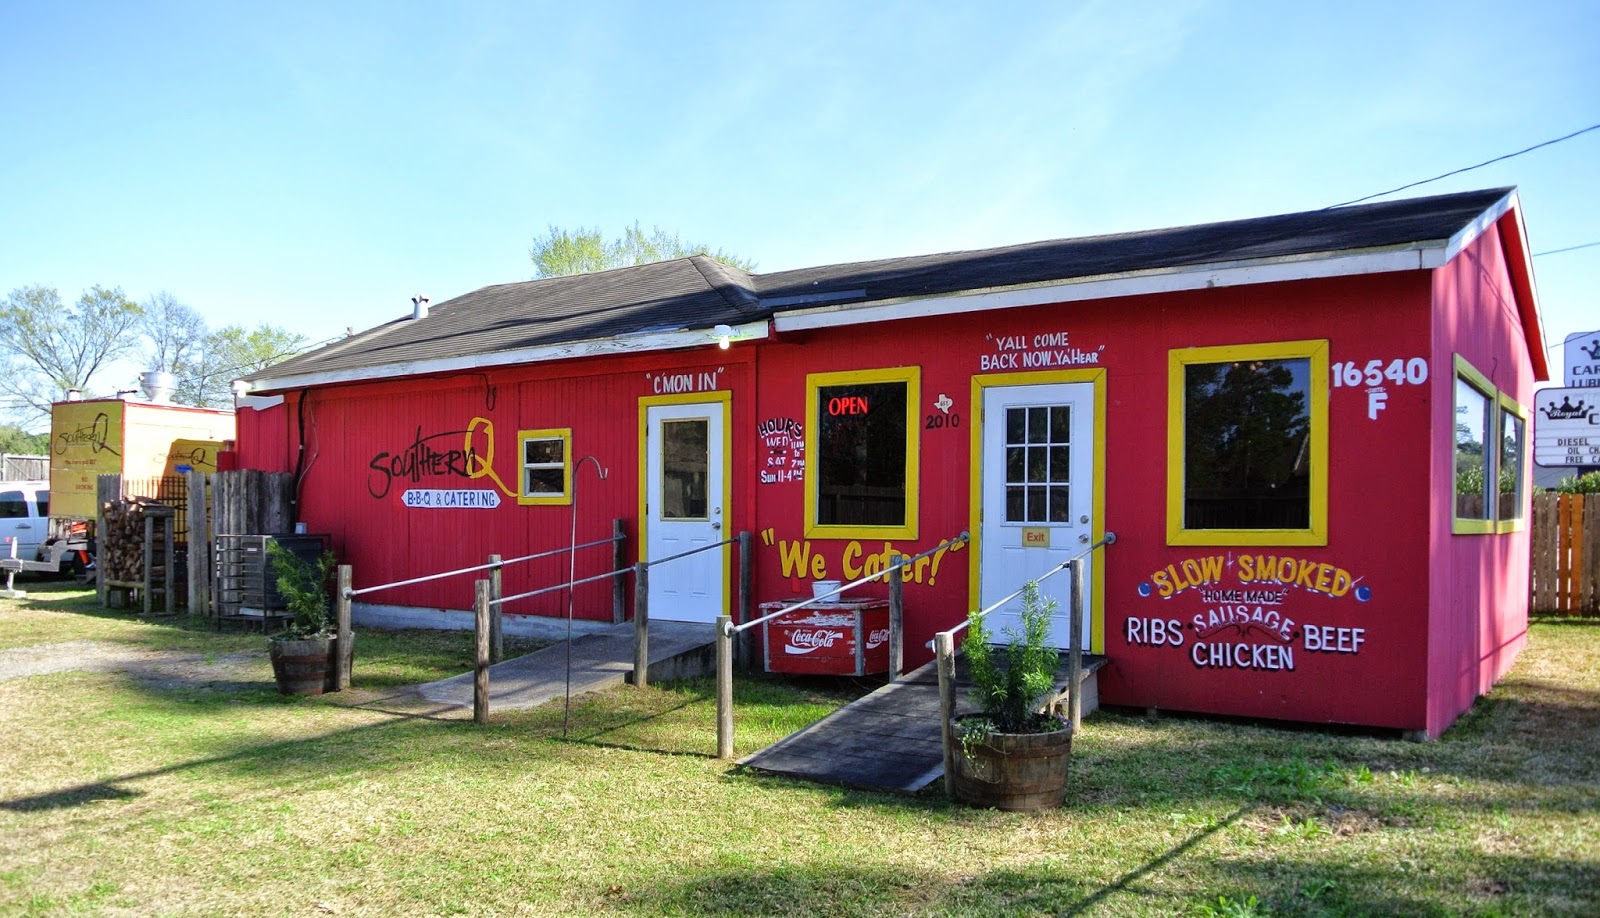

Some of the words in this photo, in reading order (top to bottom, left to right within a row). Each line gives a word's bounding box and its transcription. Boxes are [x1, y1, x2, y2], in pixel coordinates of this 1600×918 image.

[1034, 332, 1069, 348] COME
[980, 353, 1018, 371] BACK
[1331, 357, 1428, 387] 16540
[828, 396, 868, 416] OPEN
[1368, 392, 1388, 420] F
[1549, 408, 1584, 419] Royal
[758, 417, 802, 441] HOURS
[926, 414, 960, 429] 2010
[766, 436, 789, 447] WED
[1557, 438, 1589, 446] DIESEL
[767, 457, 786, 466] SAT
[435, 492, 442, 505] &
[444, 491, 495, 506] CATERING
[1026, 532, 1045, 542] Exit
[1152, 556, 1225, 598] SLOW
[1238, 555, 1352, 598] SMOKED
[1193, 605, 1295, 641] SAUSAGE
[1125, 617, 1184, 646] RIBS
[1303, 624, 1366, 653] BEEF
[1191, 642, 1295, 671] CHICKEN
